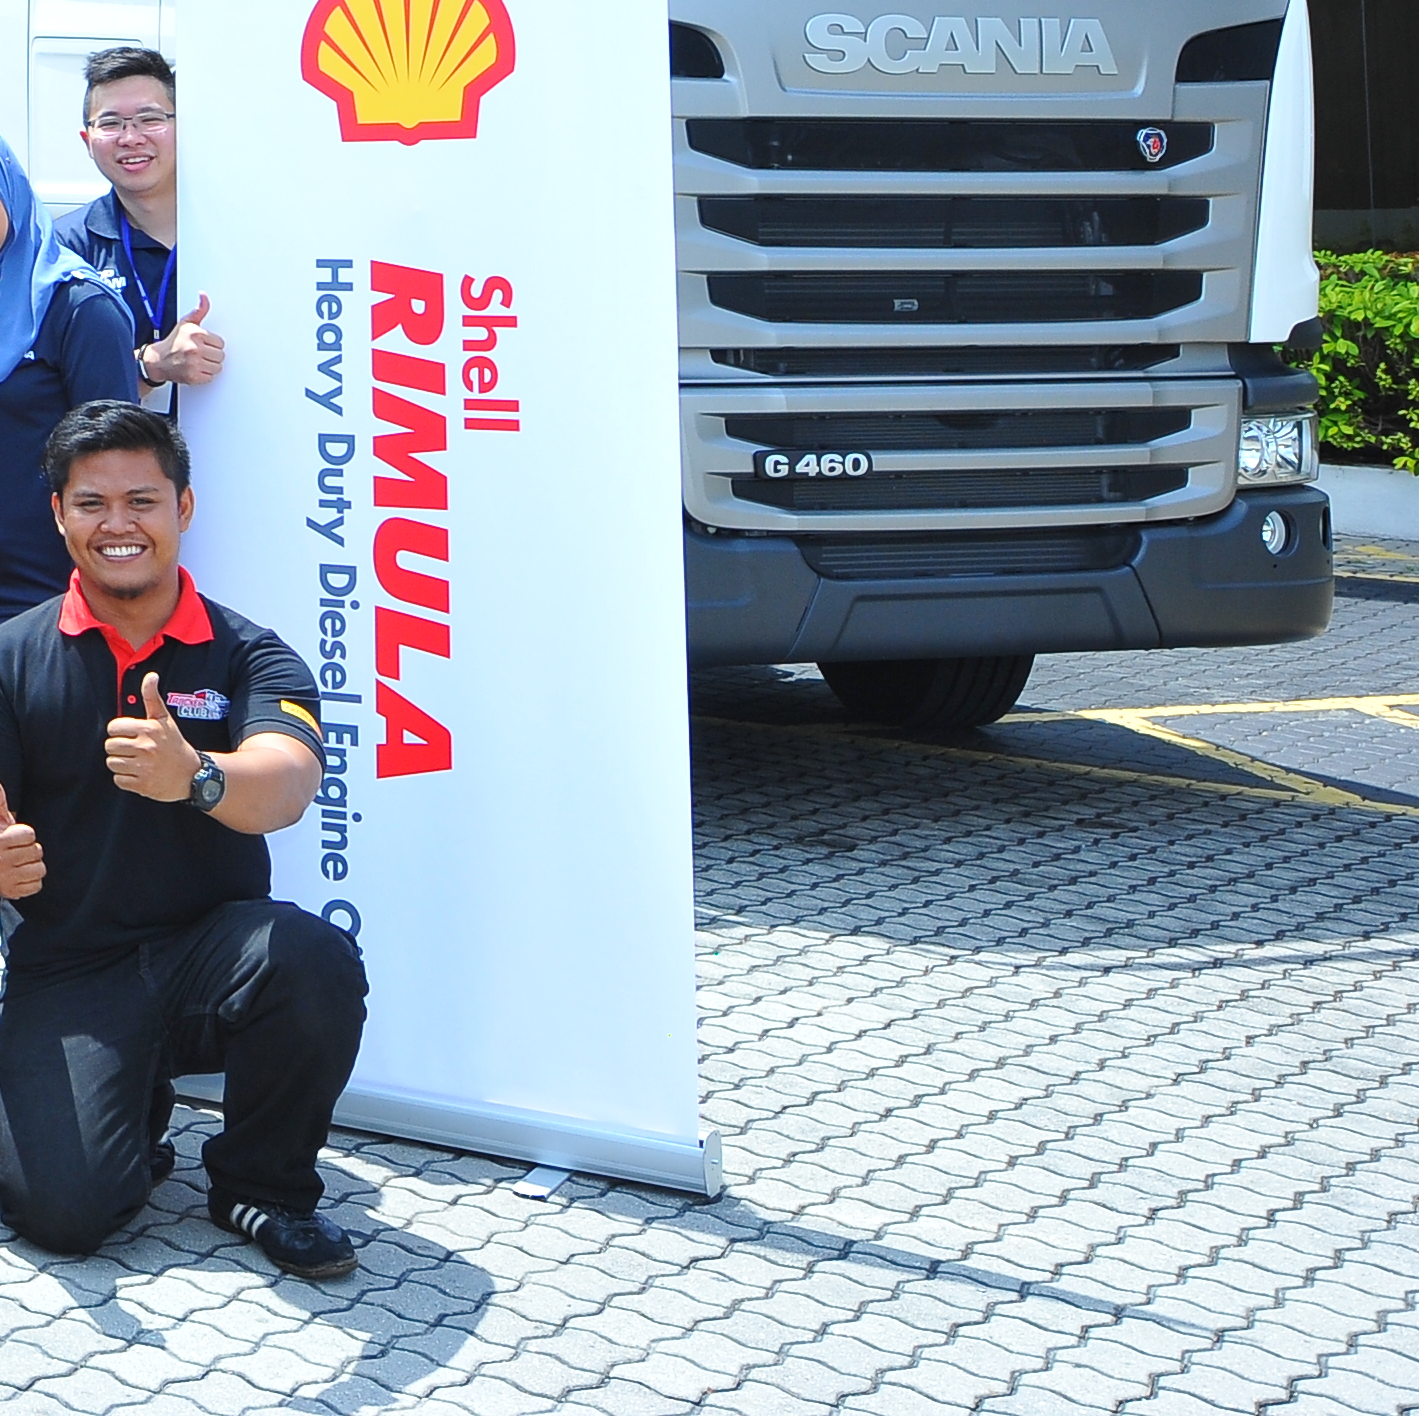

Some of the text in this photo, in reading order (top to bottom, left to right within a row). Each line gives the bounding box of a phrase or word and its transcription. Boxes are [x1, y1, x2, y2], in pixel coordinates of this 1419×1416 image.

[802, 12, 1119, 76] SCANIA
[304, 258, 354, 417] Heavy
[460, 273, 521, 432] Shell
[305, 432, 356, 548] Duty
[369, 259, 453, 780] RIMULA
[764, 452, 869, 478] G 460
[319, 562, 363, 705] Diesel
[312, 720, 363, 883] Engine
